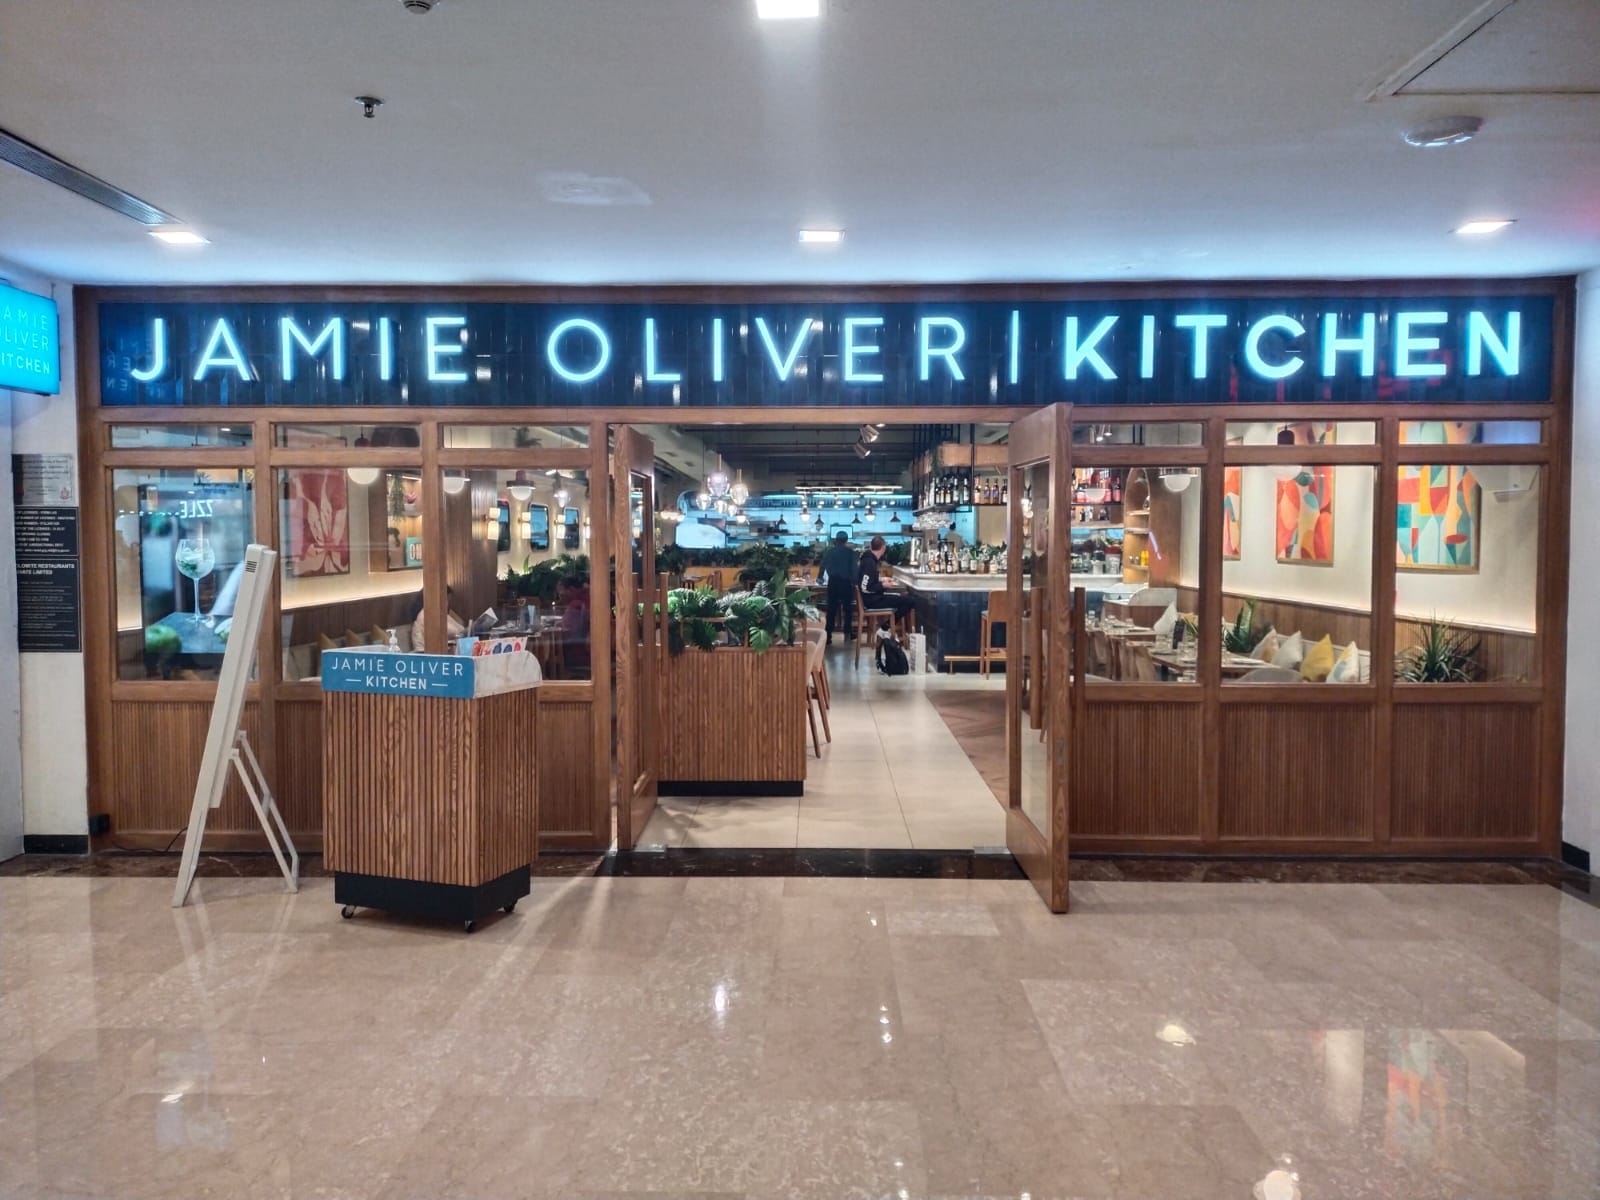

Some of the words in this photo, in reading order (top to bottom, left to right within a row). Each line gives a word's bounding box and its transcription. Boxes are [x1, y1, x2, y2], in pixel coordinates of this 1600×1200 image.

[2, 305, 48, 331] AMIE
[0, 325, 49, 352] LIVER
[130, 316, 469, 383] JAMIE
[546, 316, 966, 383] OLIVER
[1064, 310, 1522, 380] KITCHEN
[0, 352, 50, 375] ITCHEN
[332, 656, 385, 672] JAMIE
[395, 659, 464, 677] OLIVER
[366, 675, 427, 690] KITCHEN
